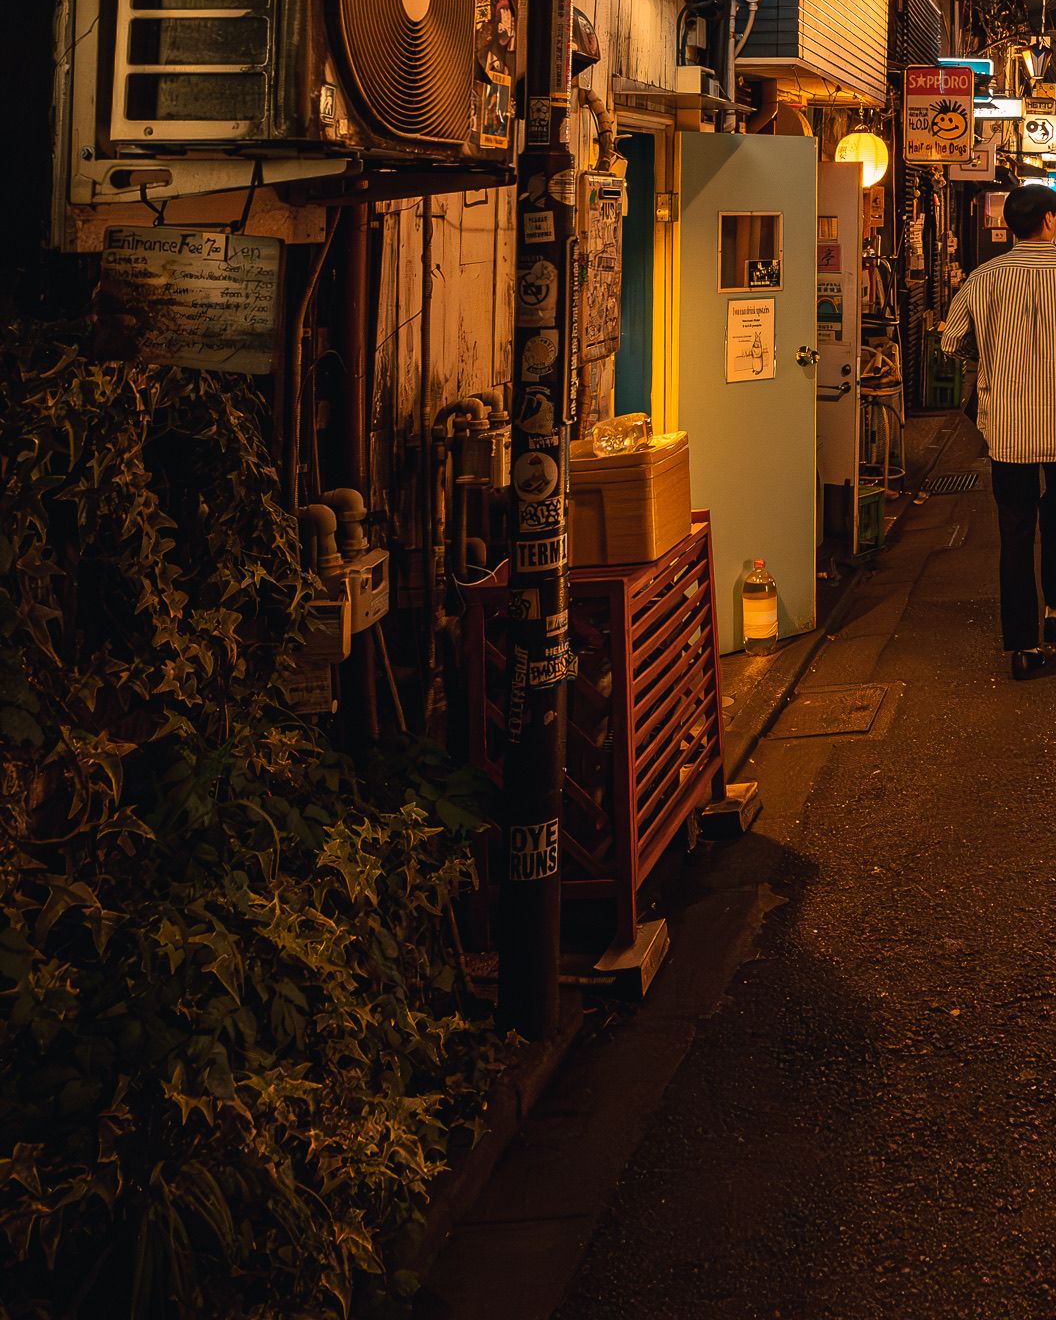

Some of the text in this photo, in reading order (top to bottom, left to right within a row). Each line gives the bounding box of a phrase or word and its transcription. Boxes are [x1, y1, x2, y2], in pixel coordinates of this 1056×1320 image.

[949, 142, 967, 156] Dogs
[108, 229, 178, 254] Entrance
[178, 233, 203, 255] Fee
[511, 822, 558, 852] DYE
[511, 845, 558, 880] RUNS
